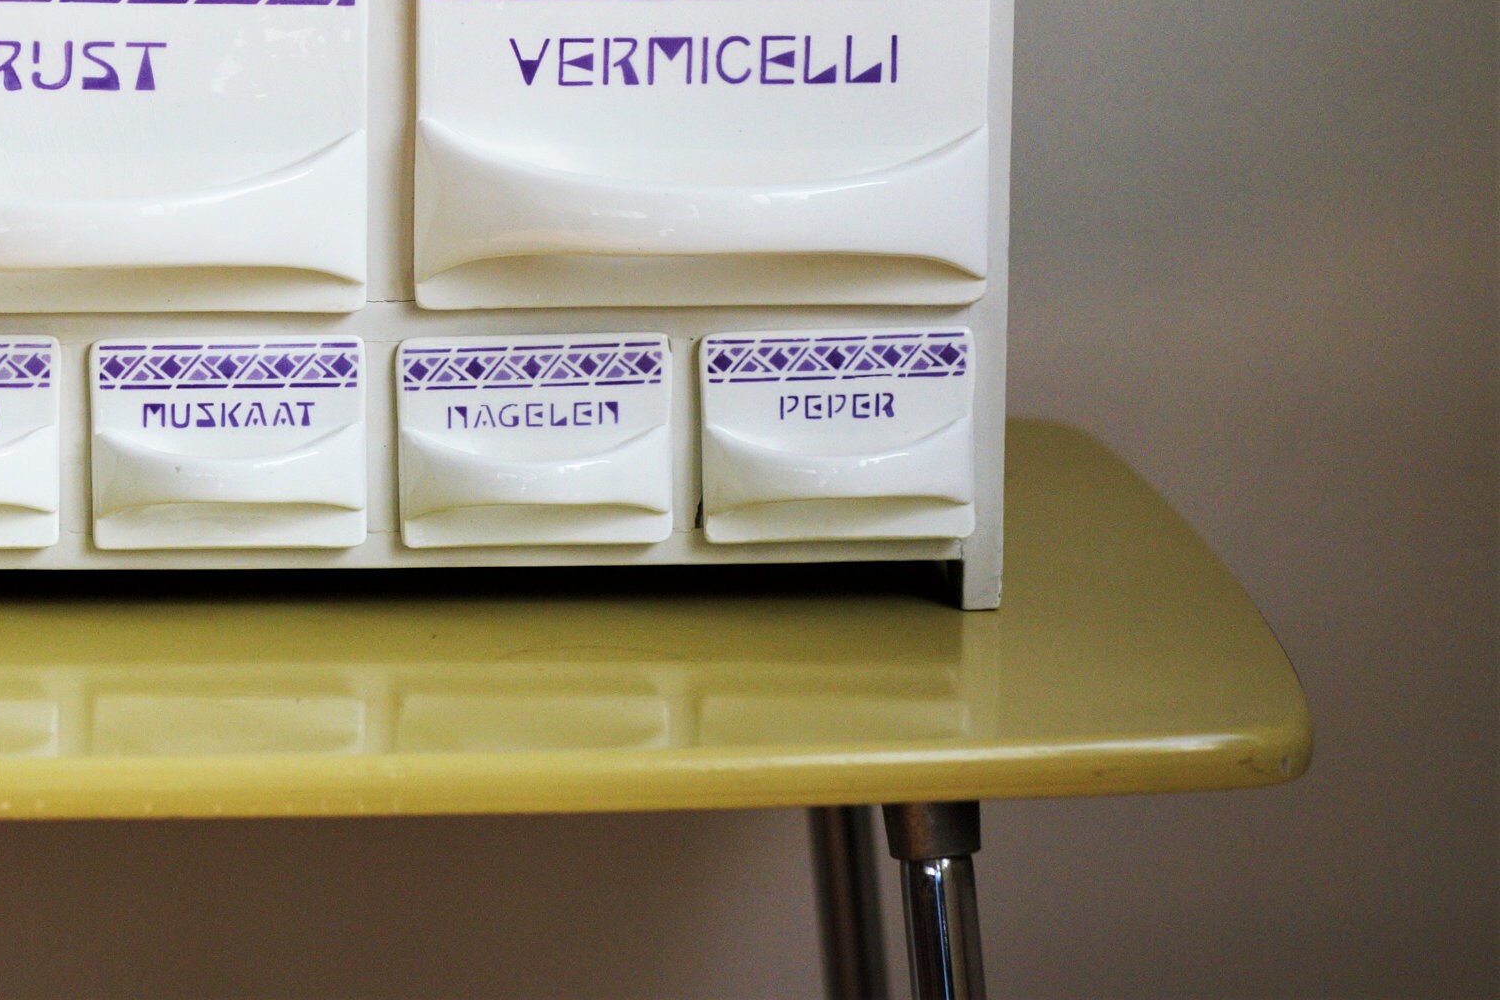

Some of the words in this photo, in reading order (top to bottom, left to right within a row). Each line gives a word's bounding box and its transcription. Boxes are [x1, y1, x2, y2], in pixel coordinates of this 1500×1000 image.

[510, 35, 900, 86] VERMICELLI
[142, 402, 316, 428] MUSKAAT
[447, 401, 619, 428] NAGELEN
[780, 392, 896, 420] PEPER
